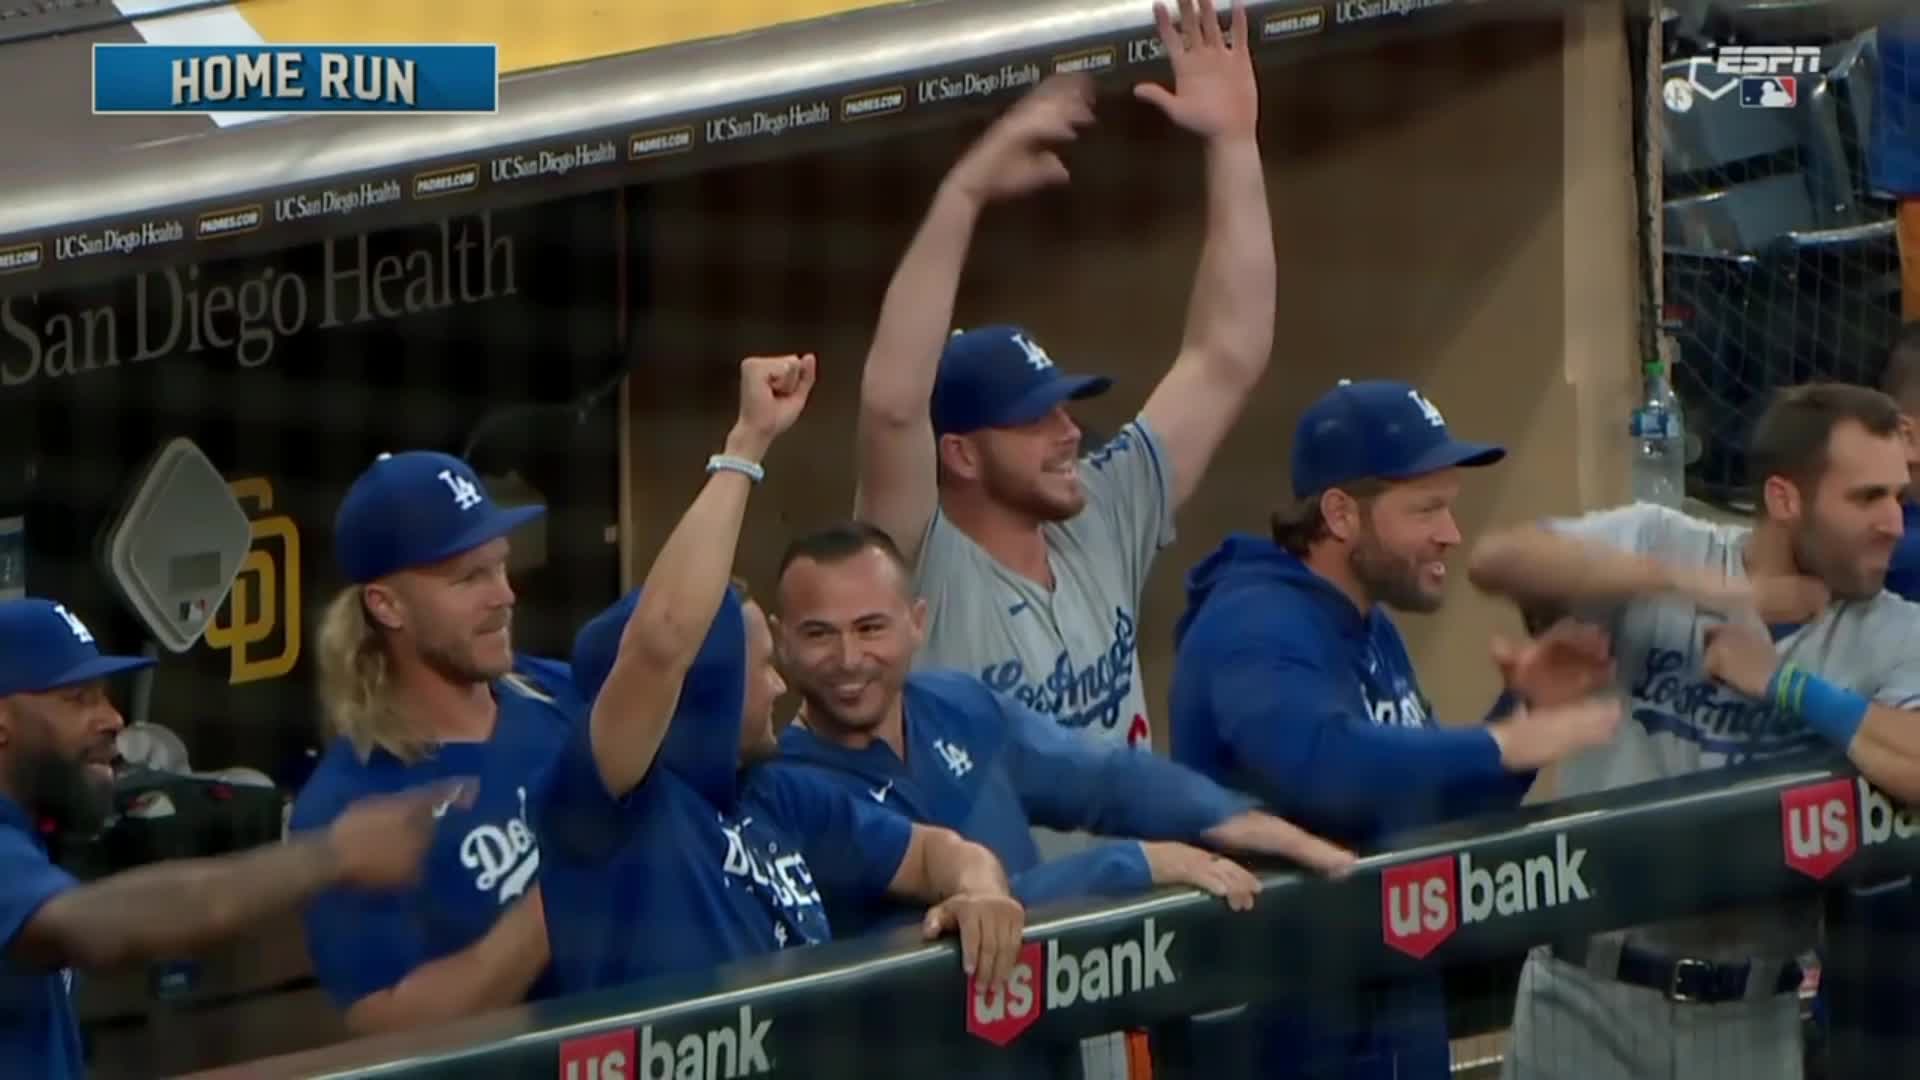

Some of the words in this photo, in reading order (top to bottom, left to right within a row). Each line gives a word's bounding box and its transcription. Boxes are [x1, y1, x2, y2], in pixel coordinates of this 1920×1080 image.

[918, 80, 937, 103] UC
[939, 77, 963, 98] San
[964, 72, 1000, 96] Diego
[1000, 63, 1041, 88] Health
[633, 132, 690, 154] PADRES.COM
[706, 119, 728, 143] UC
[728, 116, 751, 140] San
[752, 111, 789, 136] Diego
[789, 101, 830, 127] Health
[416, 171, 475, 193] PADRES.COM
[491, 157, 513, 182] UC
[513, 155, 538, 179] San
[539, 151, 575, 175] Diego
[575, 141, 616, 168] Health
[275, 198, 297, 222] UC
[297, 194, 322, 218] San
[323, 191, 359, 215] Diego
[359, 179, 400, 207] Health
[55, 235, 77, 260] UC
[78, 234, 103, 256] San
[104, 229, 141, 254] Diego
[141, 220, 184, 246] Health
[199, 211, 259, 233] PADRES.COM
[0, 292, 122, 387] San
[132, 262, 307, 368] Diego
[319, 212, 518, 330] Health
[437, 469, 482, 511] LA
[933, 739, 974, 777] LA
[1789, 799, 1850, 858] us
[1389, 877, 1450, 937] us
[1459, 833, 1591, 924] bank
[974, 964, 1034, 1024] us
[1047, 918, 1176, 1009] bank
[640, 1004, 773, 1080] bank
